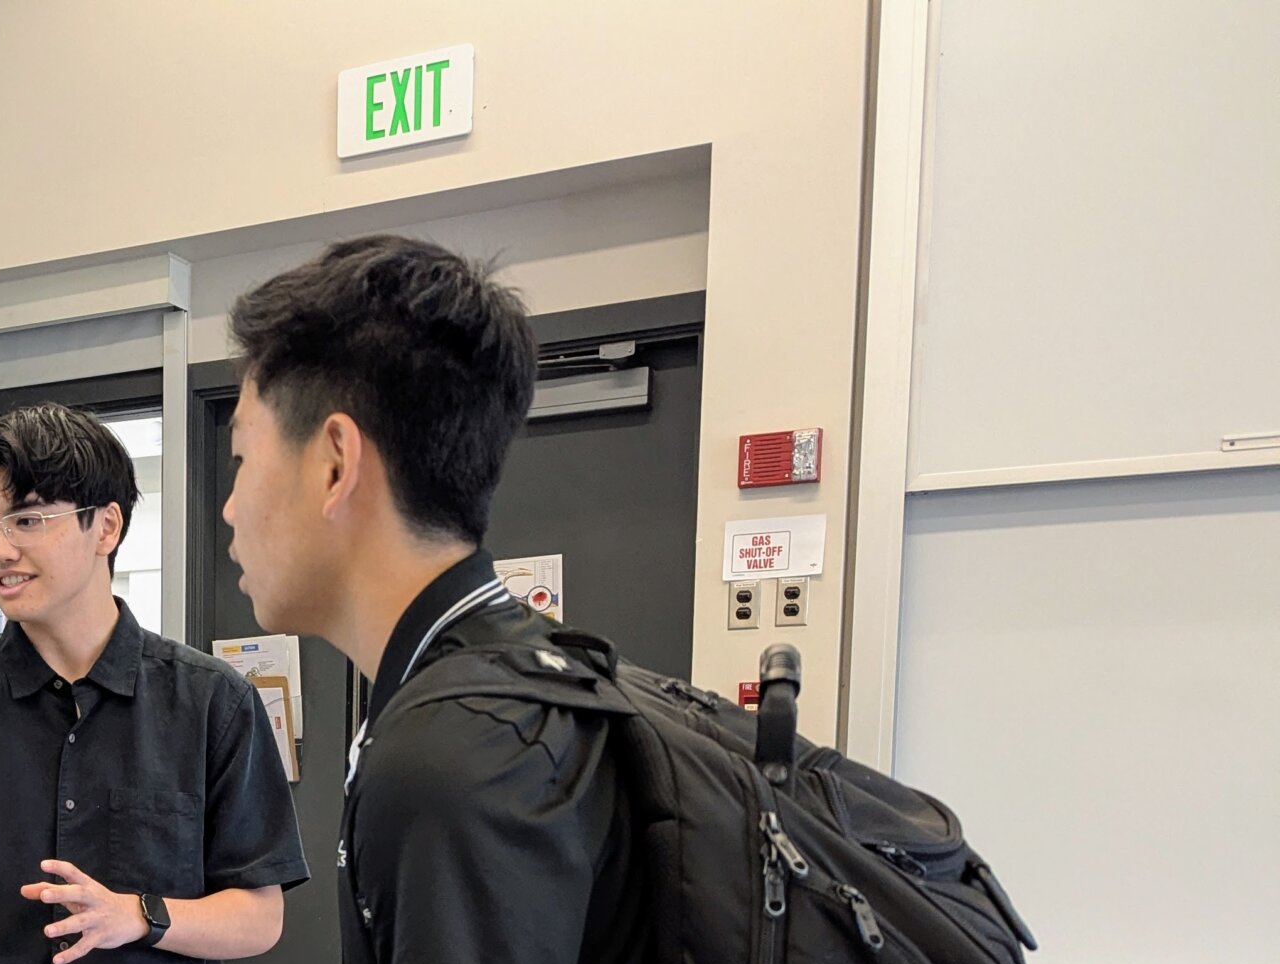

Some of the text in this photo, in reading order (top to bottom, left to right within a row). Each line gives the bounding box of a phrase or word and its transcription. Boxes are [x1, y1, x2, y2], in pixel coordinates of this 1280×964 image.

[366, 60, 450, 141] EXIT
[743, 443, 752, 477] FIRE
[751, 535, 771, 547] GAS
[739, 545, 783, 559] SHUT-OFF
[746, 557, 775, 570] VALVE
[742, 683, 753, 691] FIRE
